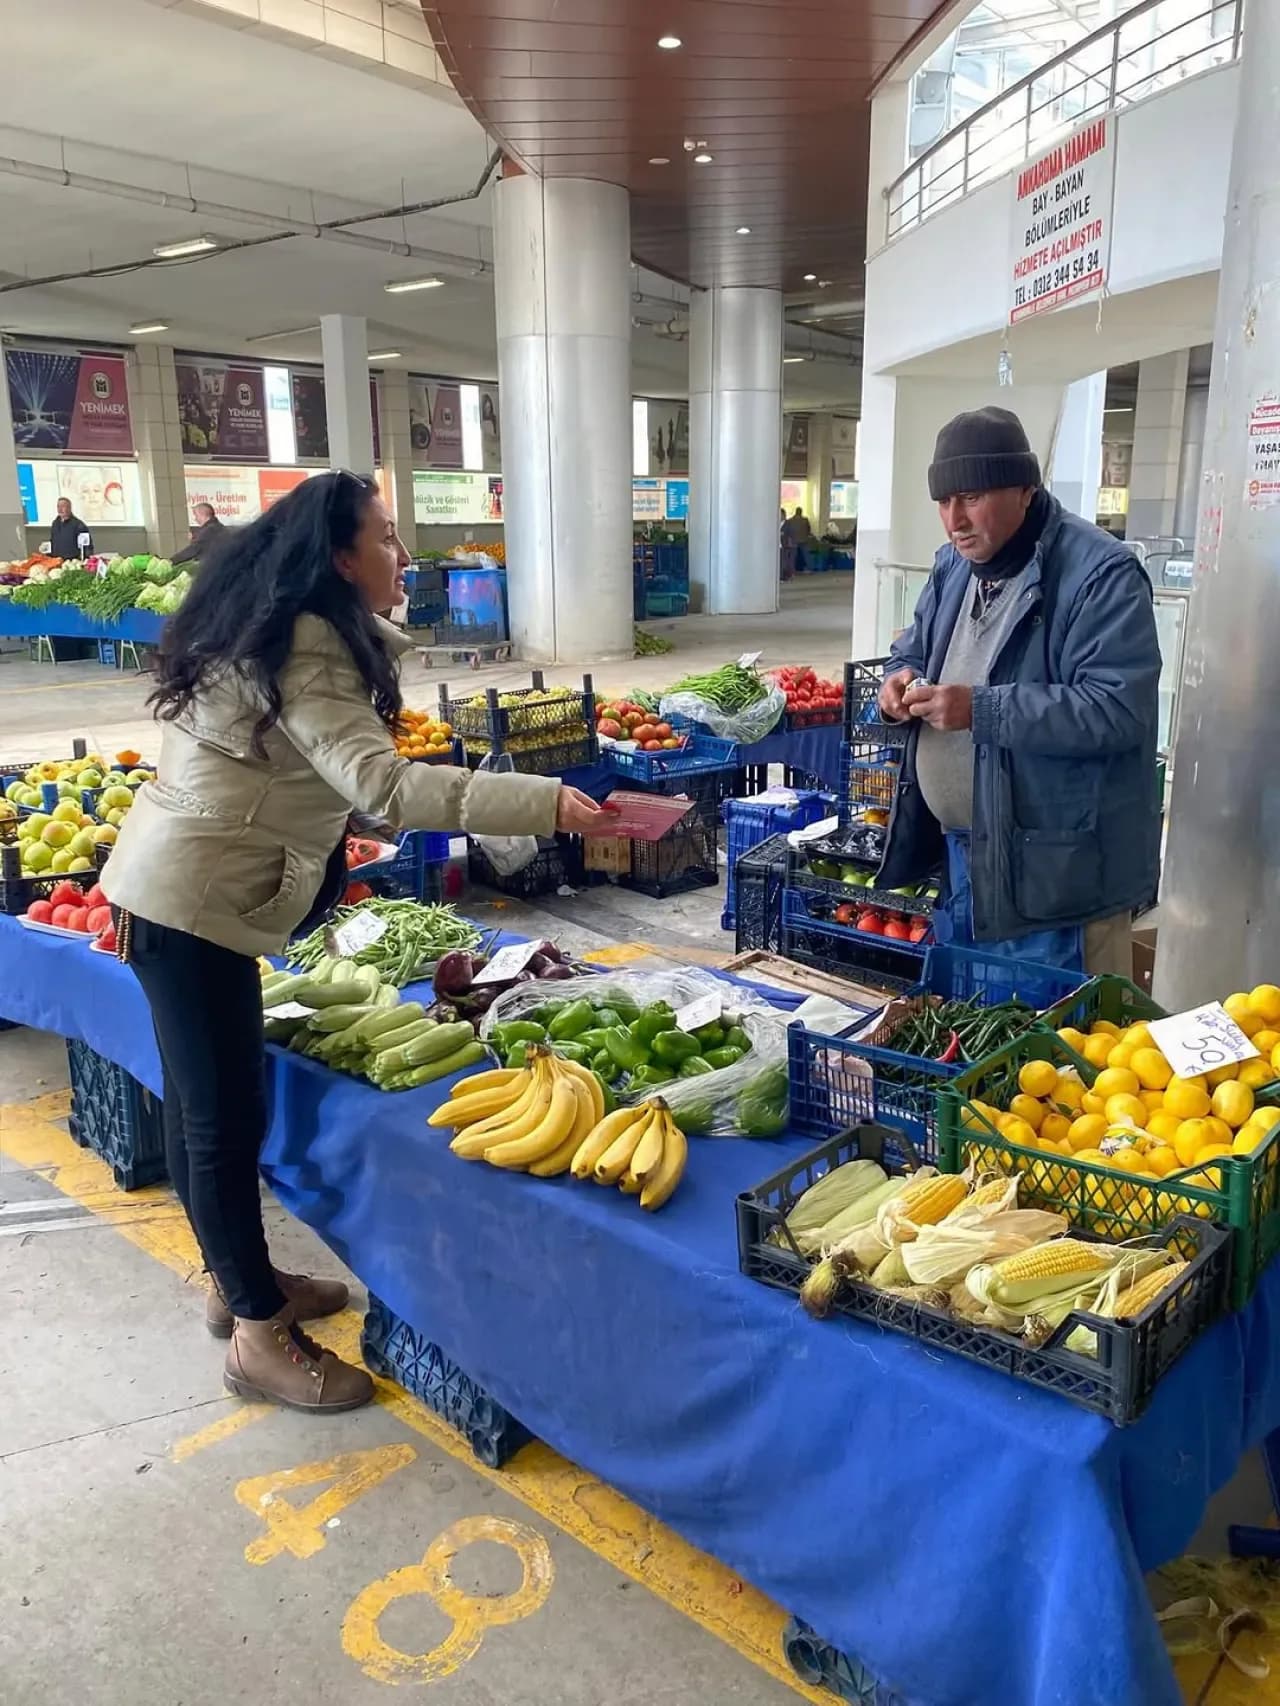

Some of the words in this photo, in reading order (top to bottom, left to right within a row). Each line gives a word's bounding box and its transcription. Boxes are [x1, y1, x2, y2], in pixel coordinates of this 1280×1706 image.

[1018, 147, 1062, 200] ANKAROMA
[1065, 119, 1105, 165] HAMAMI
[1032, 191, 1048, 216] BAY
[1055, 170, 1085, 204] BAYAN
[1024, 195, 1091, 247] BÖLÜMLERİYLE
[1013, 248, 1049, 281] HİZMETE
[1049, 218, 1103, 263] AÇILMIŞTIR
[1015, 286, 1027, 307] TEL
[1033, 273, 1052, 298] 0312
[1054, 262, 1070, 288] 344
[1073, 255, 1084, 280] 54
[1087, 249, 1100, 275] 34
[79, 401, 126, 415] YENİMEK
[215, 491, 247, 503] Üretim
[1182, 1035, 1225, 1063] 50
